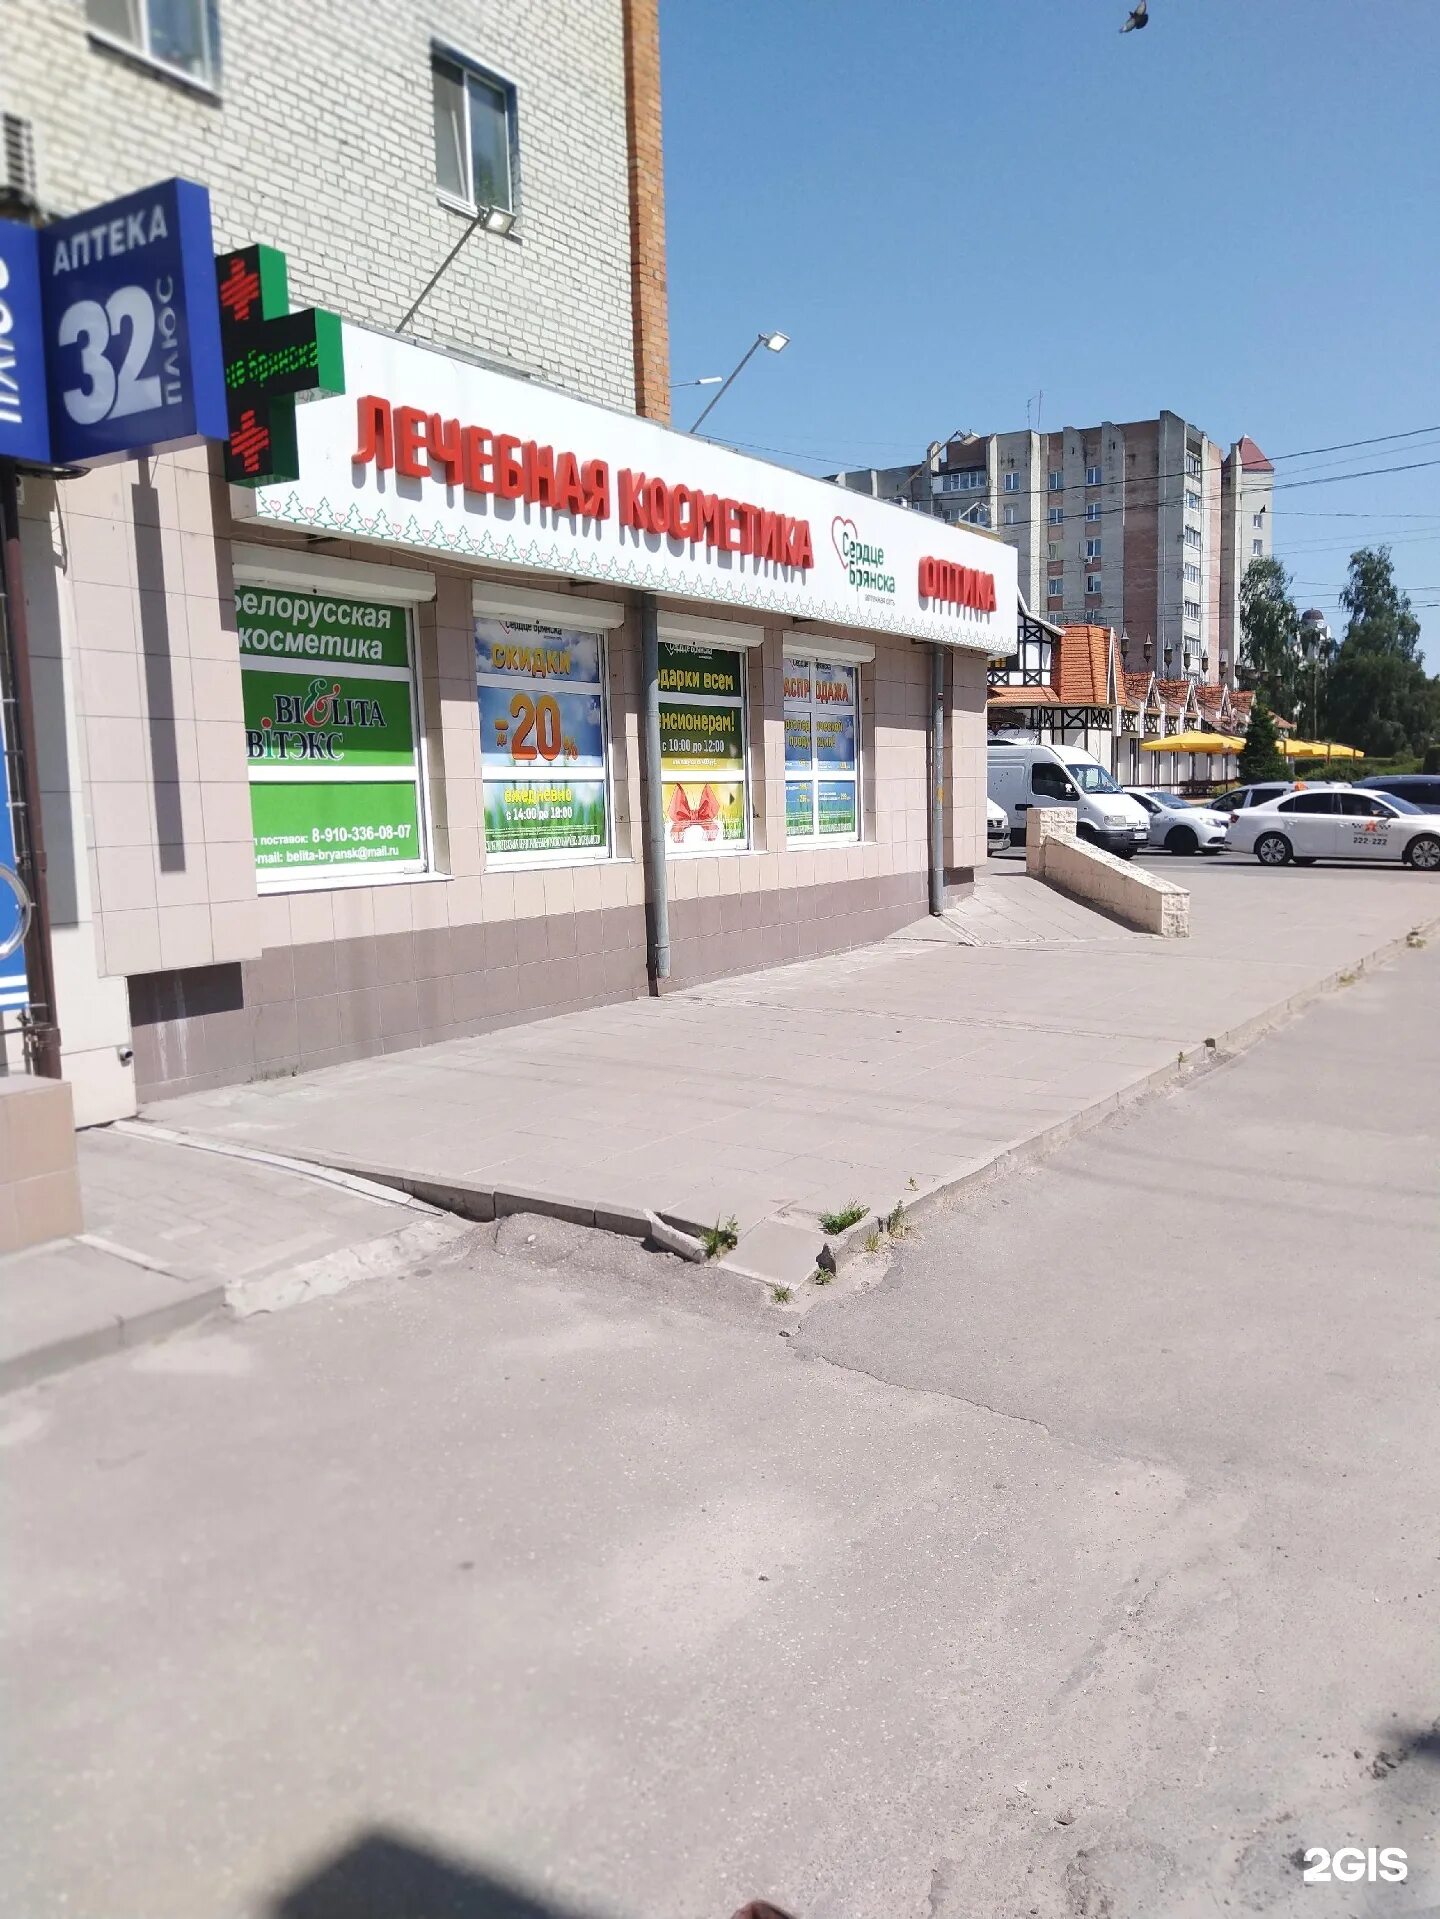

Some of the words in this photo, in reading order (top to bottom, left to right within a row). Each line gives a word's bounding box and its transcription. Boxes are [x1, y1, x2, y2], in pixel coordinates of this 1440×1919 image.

[53, 205, 168, 275] АПТЕКА
[58, 285, 163, 425] 32
[156, 275, 182, 405] ПЛЮС
[351, 394, 610, 521] ЛЕЧЕБНАЯ
[617, 467, 815, 570] КОСМЕТИКА
[842, 531, 884, 568] Сердце
[849, 560, 895, 593] Брянска
[918, 555, 997, 612] ОПТИКА
[238, 627, 383, 660] косметика
[491, 643, 572, 679] СКИДКИ
[703, 672, 734, 691] всем
[669, 738, 690, 752] 10:00
[692, 742, 702, 753] до
[704, 739, 724, 752] 12:00
[504, 787, 572, 804] ежедневно
[513, 806, 536, 820] 14:00
[551, 806, 573, 819] 18:00
[260, 834, 308, 845] поставок:
[312, 824, 411, 843] 8-910-336-08-07
[286, 845, 399, 862] belita-bryansk@mail.ru
